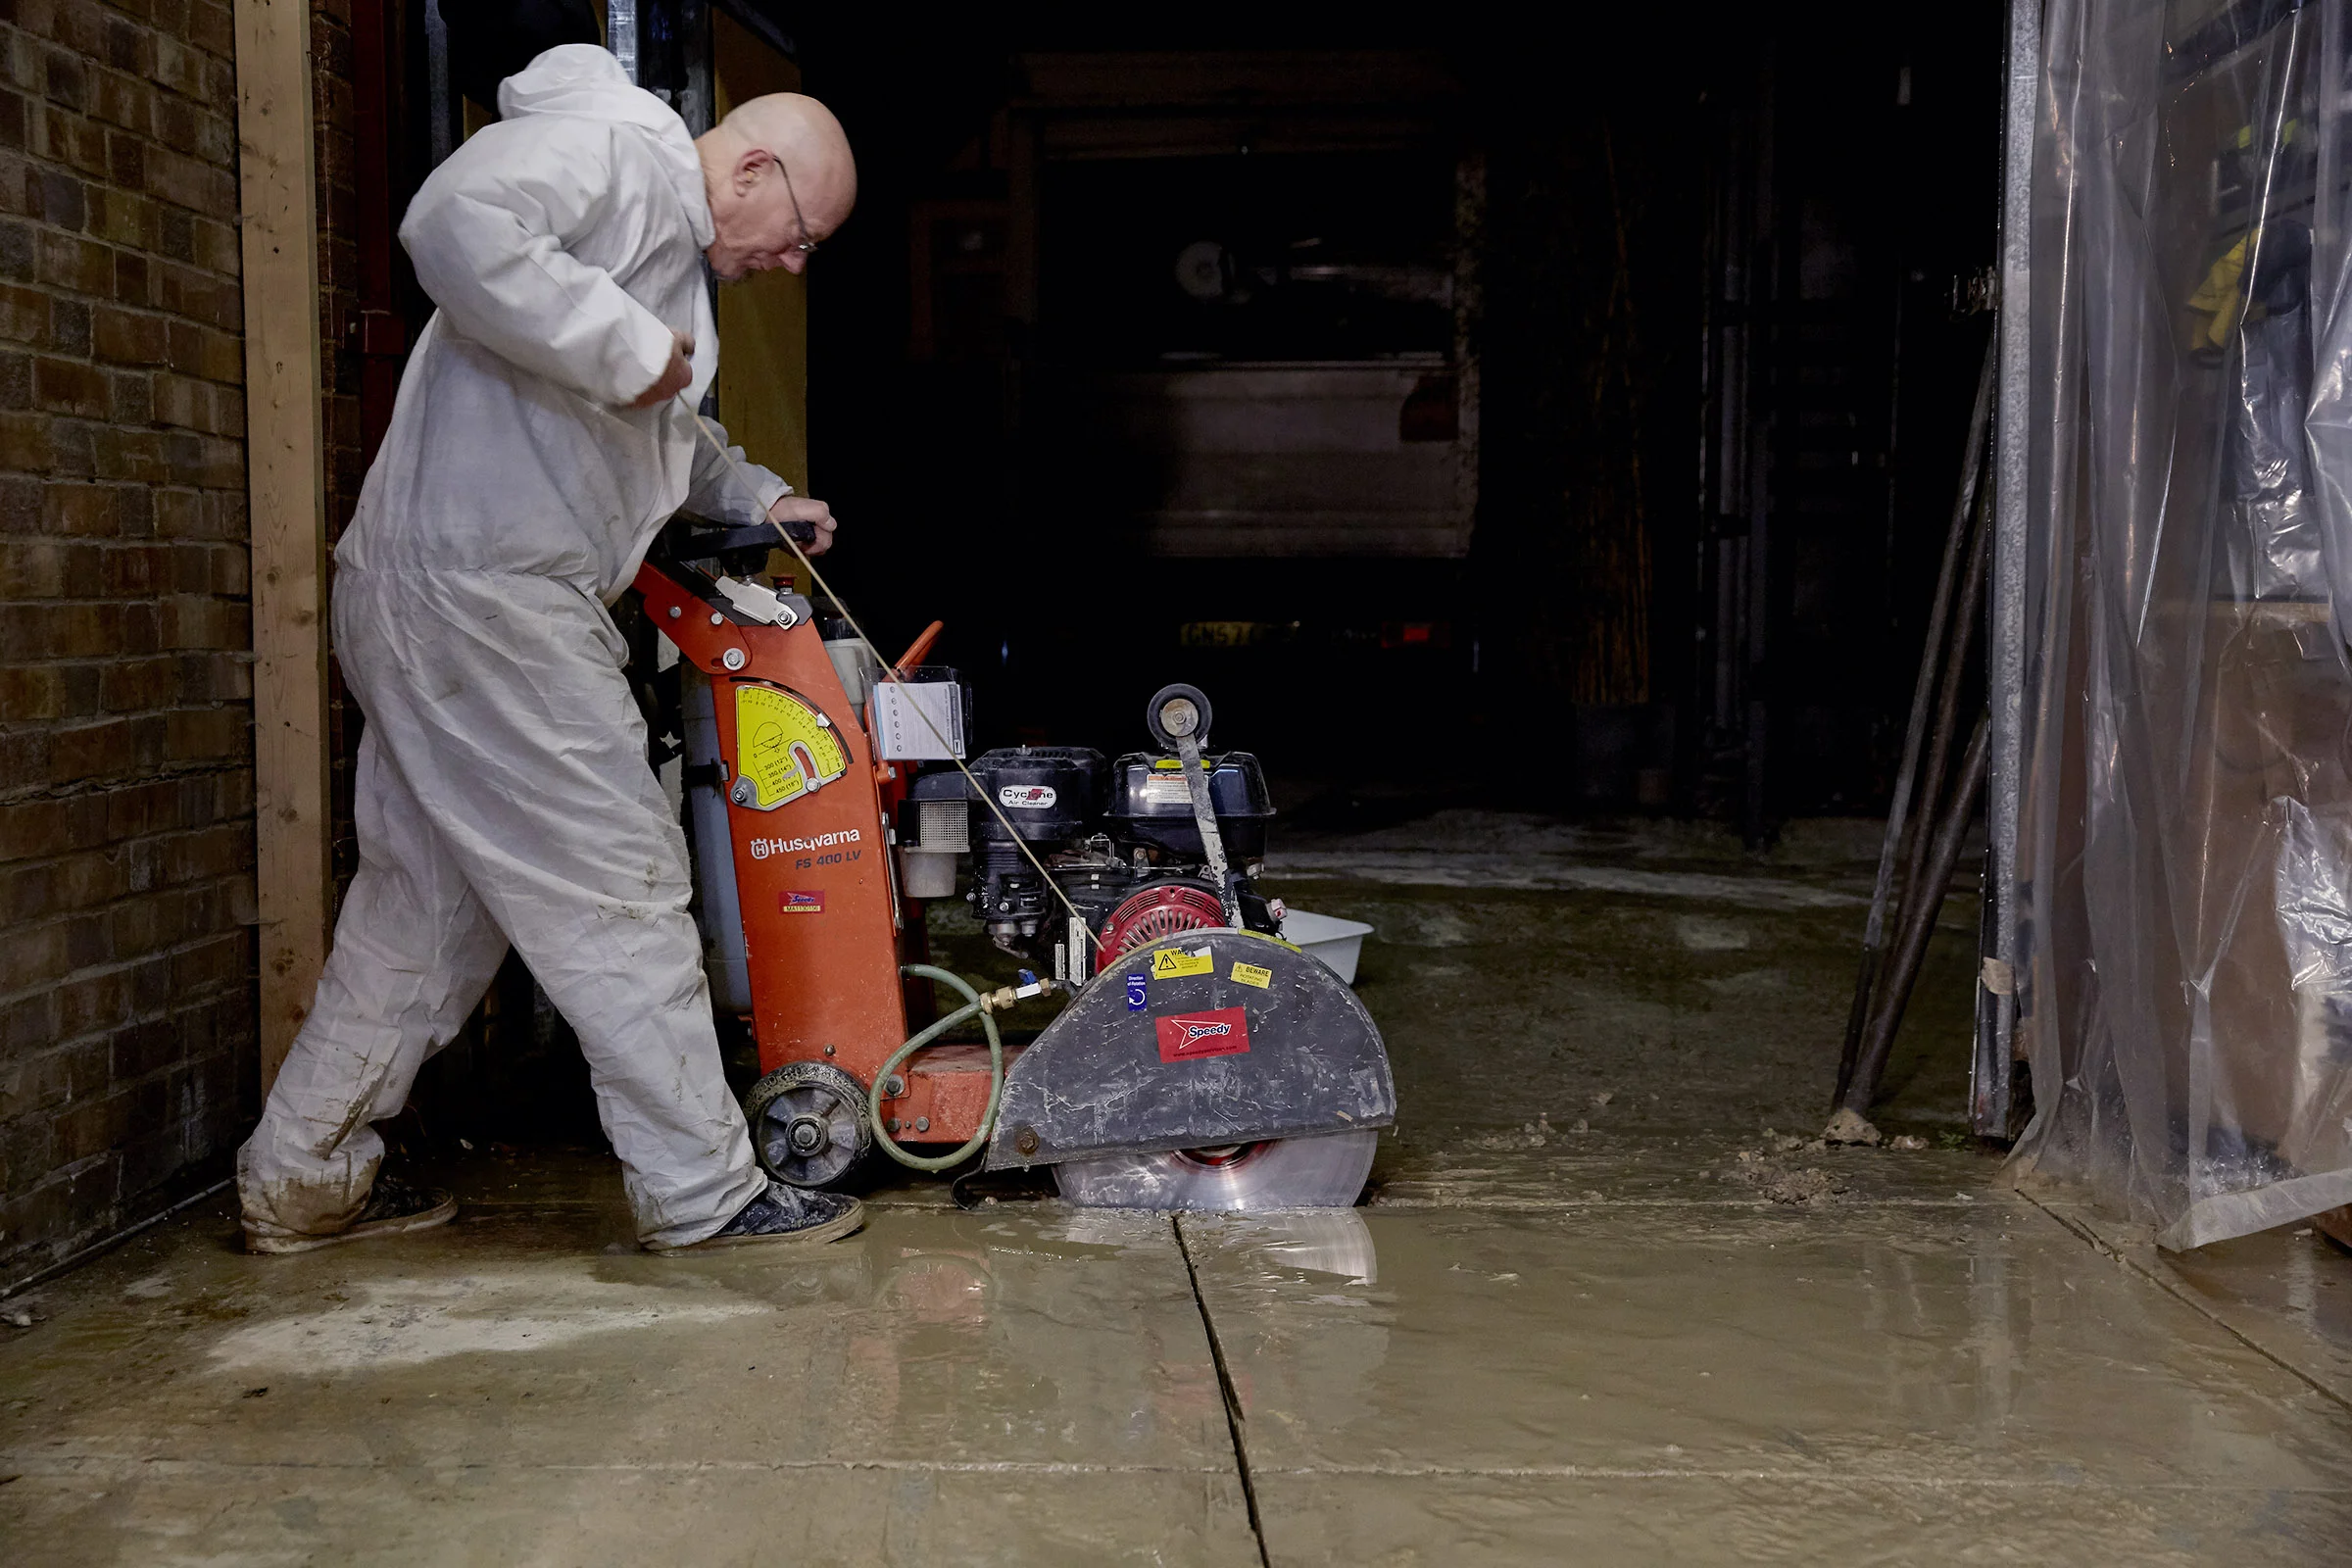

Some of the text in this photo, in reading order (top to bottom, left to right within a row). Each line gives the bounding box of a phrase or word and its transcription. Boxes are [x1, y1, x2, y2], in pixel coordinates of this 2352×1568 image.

[769, 828, 860, 855] Husqvarna
[795, 850, 861, 870] FS 400 LV
[1245, 965, 1270, 977] BEWARE
[1189, 1023, 1231, 1038] Speedy
